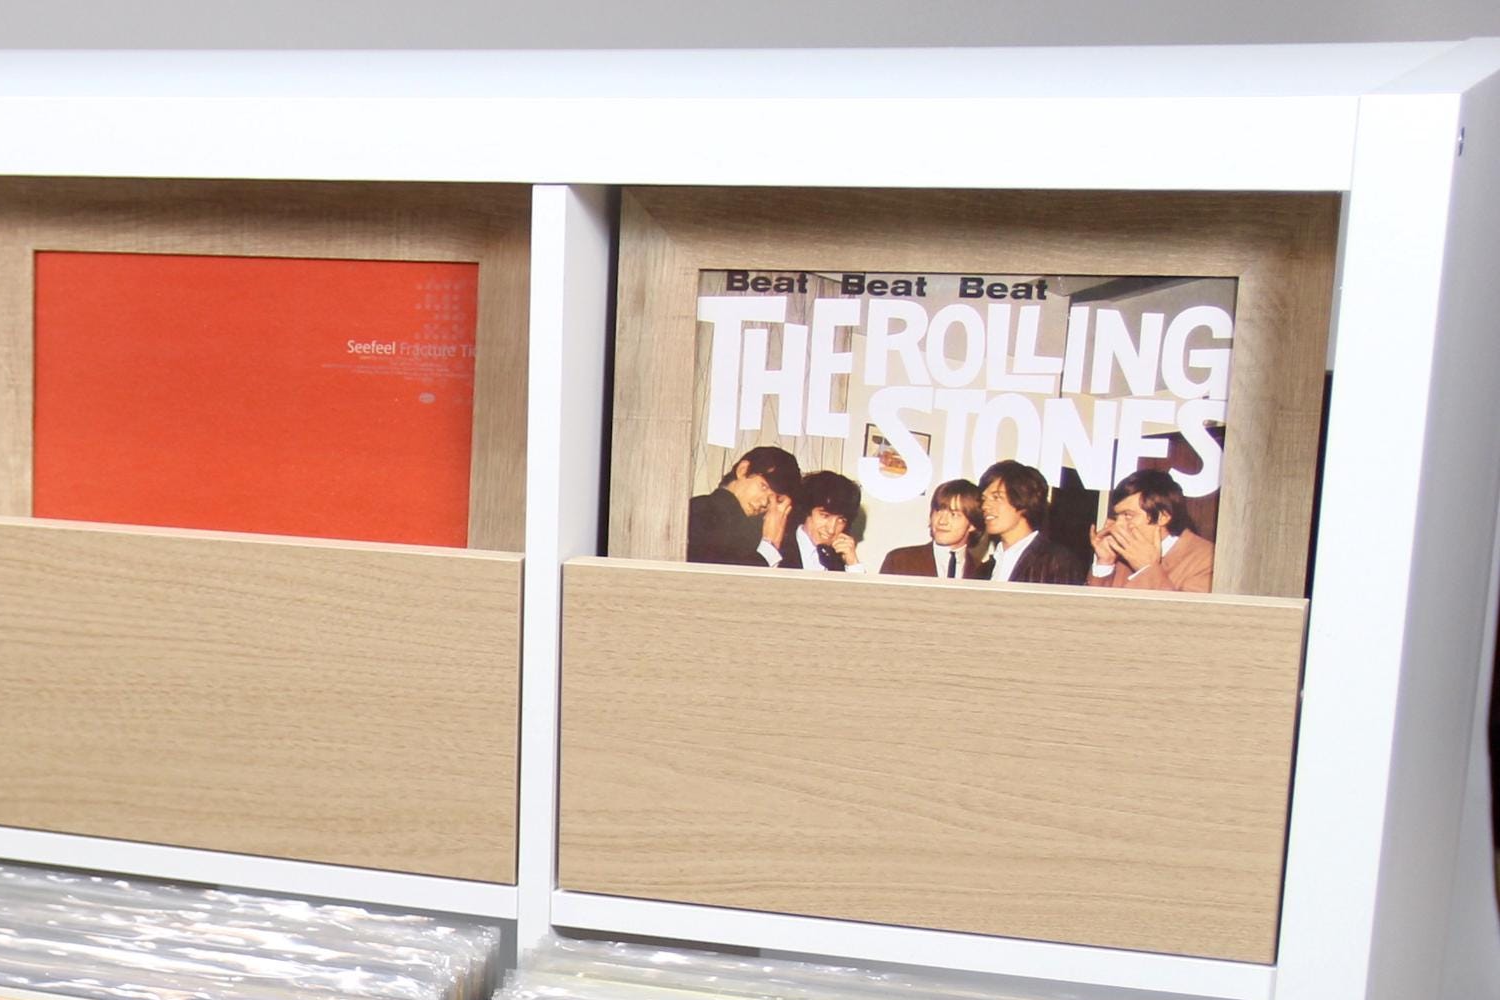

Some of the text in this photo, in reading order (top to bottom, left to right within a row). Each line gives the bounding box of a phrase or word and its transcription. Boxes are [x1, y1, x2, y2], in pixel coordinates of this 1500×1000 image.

[726, 270, 1049, 301] Beat Beat Beat
[347, 339, 396, 355] Seefeel
[400, 342, 456, 358] Fracture
[697, 295, 1236, 448] THE ROLLING
[858, 385, 1228, 502] STONES
